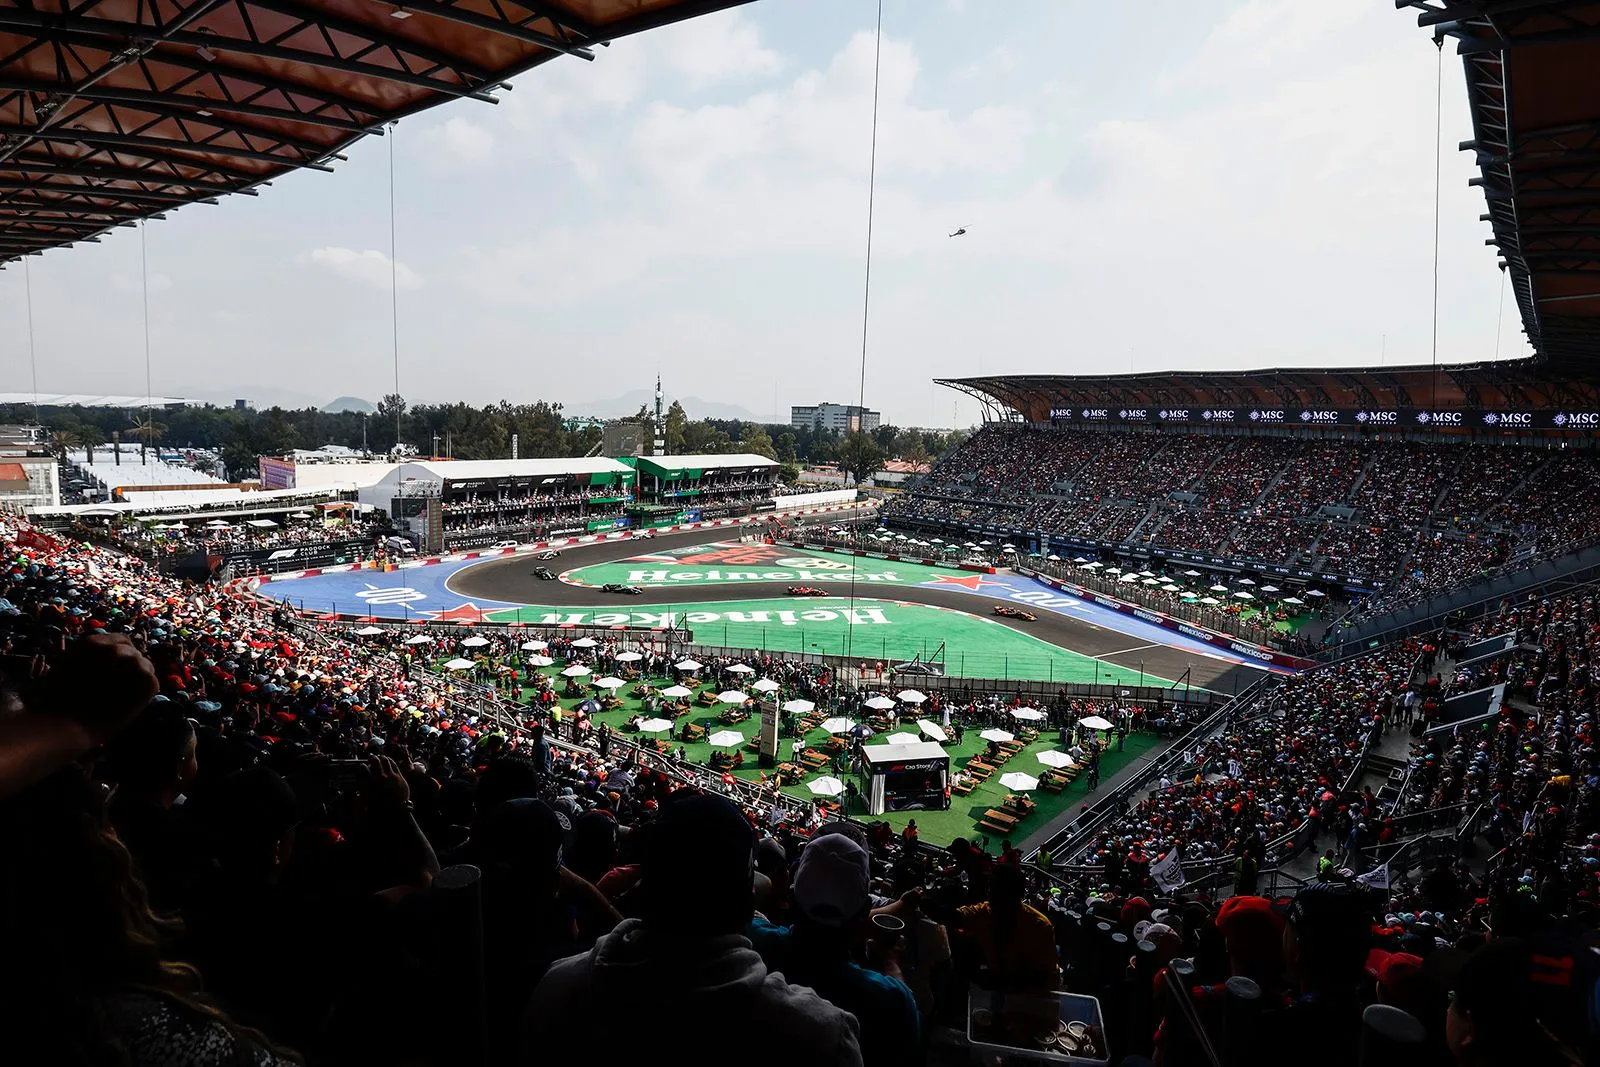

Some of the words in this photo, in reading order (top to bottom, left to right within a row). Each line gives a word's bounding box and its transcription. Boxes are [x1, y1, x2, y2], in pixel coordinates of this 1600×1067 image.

[1056, 409, 1072, 417] MSC
[1090, 409, 1108, 417] MSC
[1128, 409, 1147, 417] MSC
[1169, 410, 1189, 418] MSC
[1213, 410, 1234, 418] MSC
[1261, 411, 1284, 419] MSC
[1313, 411, 1338, 420] MSC
[1370, 412, 1397, 421] MSC
[1433, 413, 1462, 422] MSC
[1500, 413, 1532, 423] MSC
[1568, 413, 1599, 423] MSC
[539, 608, 892, 627] Heineken
[1178, 625, 1214, 641] #MexicoGP
[1230, 643, 1274, 661] #MexicoGP
